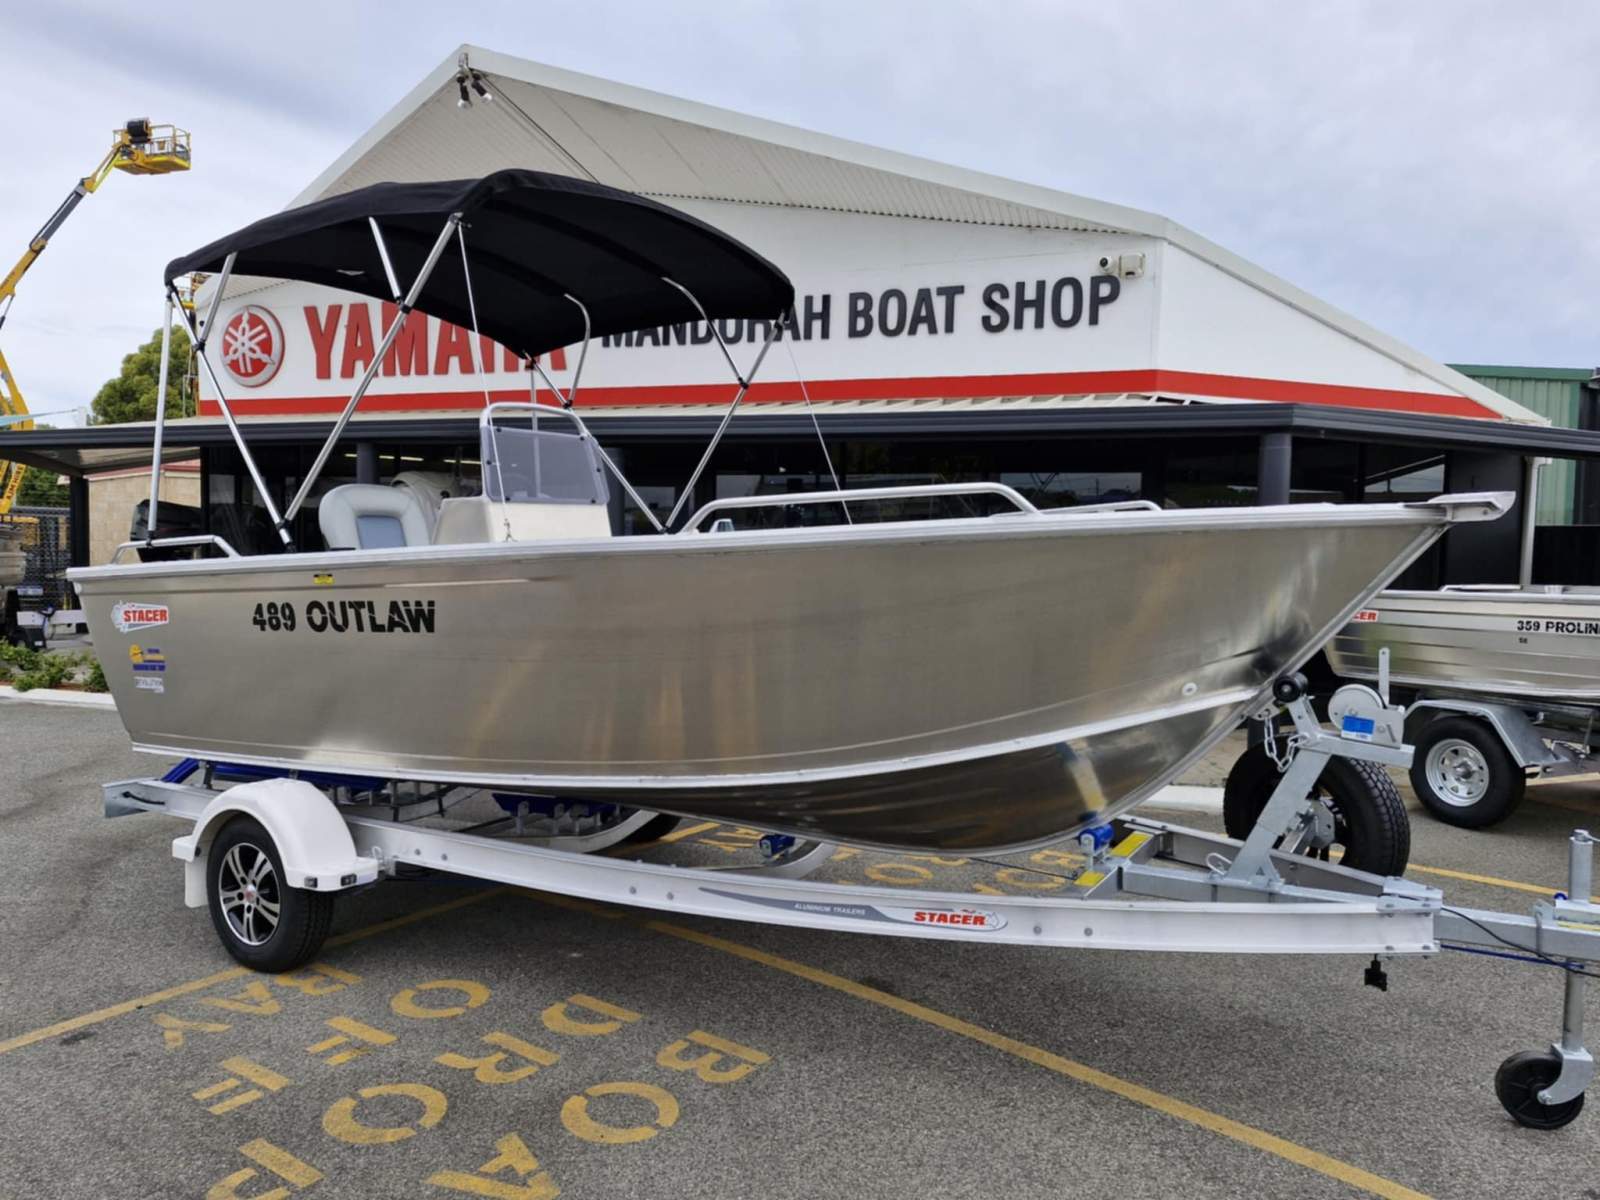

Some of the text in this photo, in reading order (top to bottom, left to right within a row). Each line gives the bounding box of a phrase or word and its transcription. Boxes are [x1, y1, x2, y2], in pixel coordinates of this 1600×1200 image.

[848, 285, 965, 338] BOAT
[981, 275, 1121, 334] SHOP
[123, 609, 168, 623] STACER
[252, 600, 436, 633] 489 OUTLAW
[1517, 620, 1600, 635] 359 PROLIN
[914, 911, 986, 926] STACER
